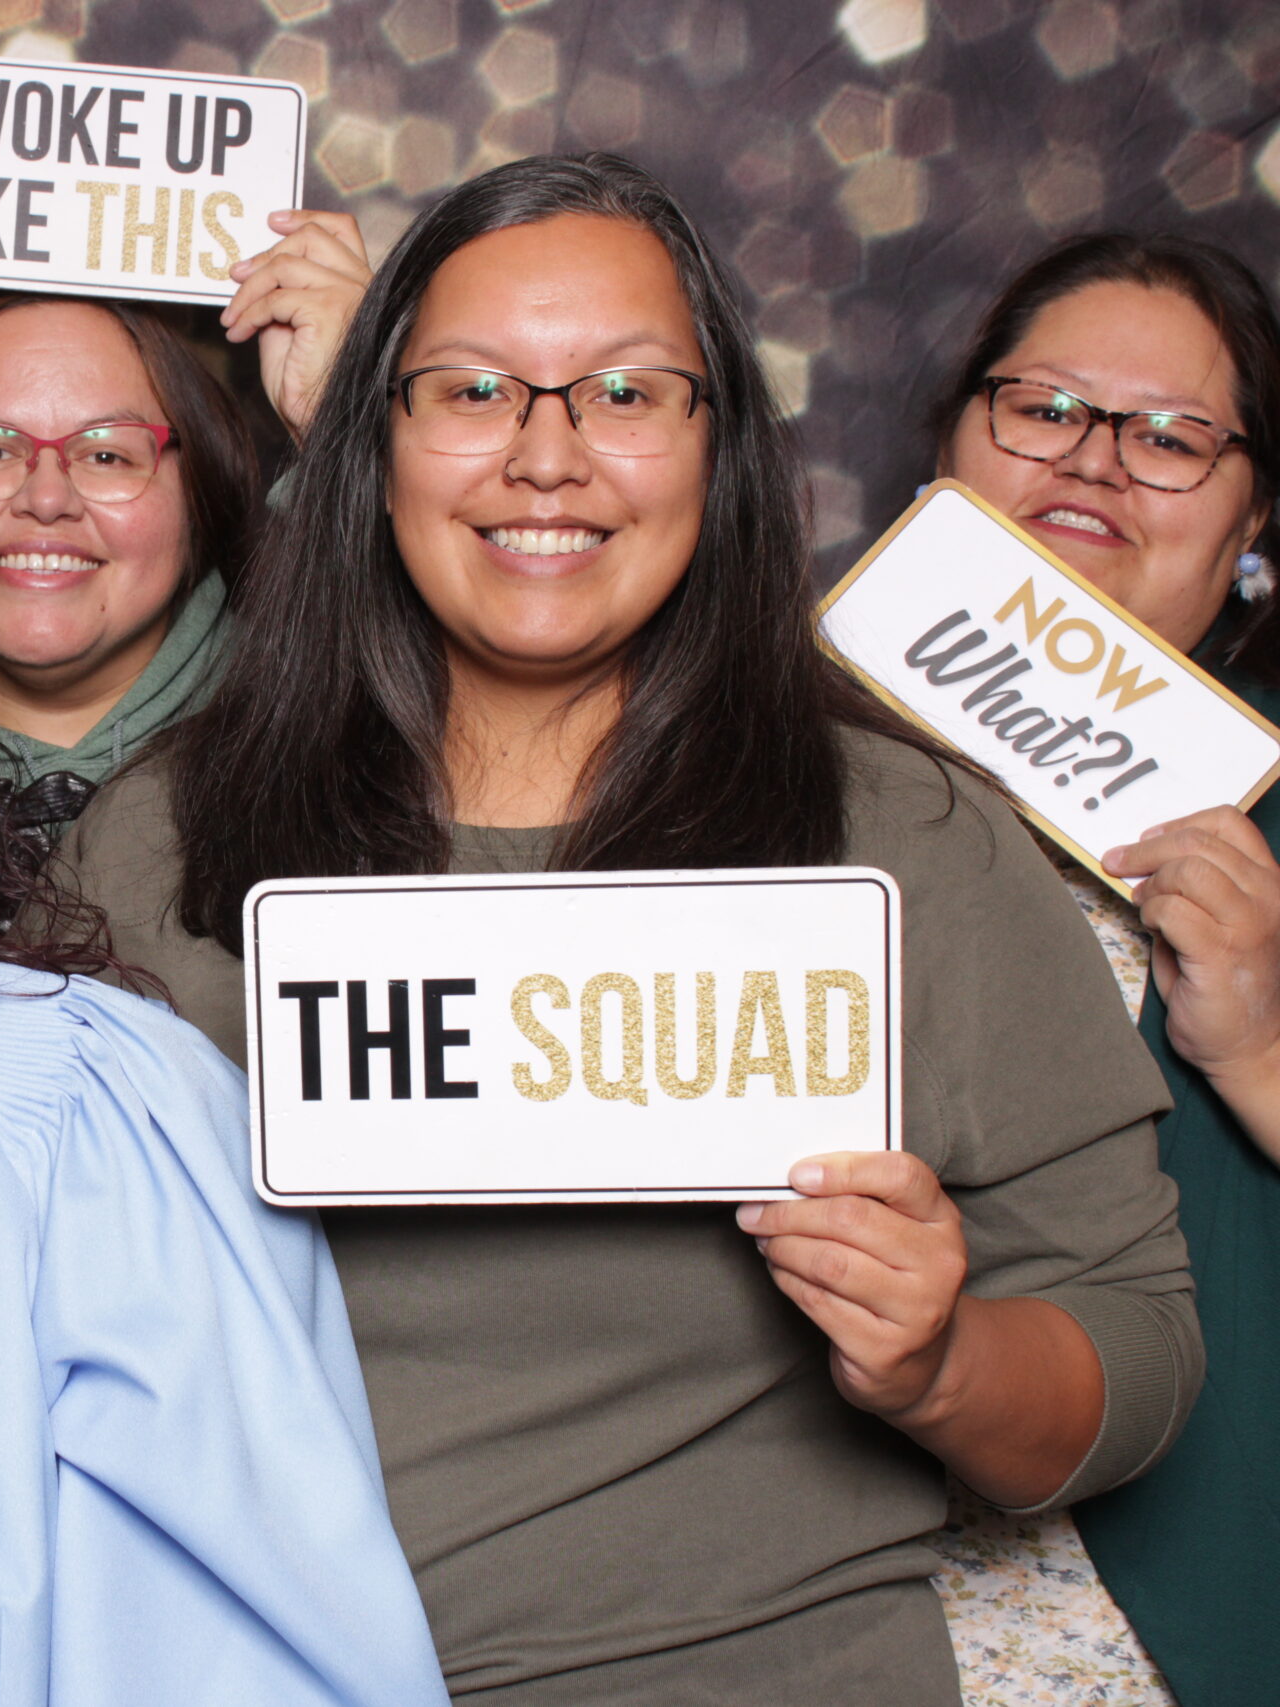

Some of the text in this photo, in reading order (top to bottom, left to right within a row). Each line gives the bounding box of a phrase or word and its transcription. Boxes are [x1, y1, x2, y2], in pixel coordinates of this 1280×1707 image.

[166, 93, 253, 175] UP
[76, 180, 245, 281] THIS
[904, 609, 1160, 811] What?!
[993, 576, 1170, 713] NOW
[278, 969, 871, 1107] THE SQUAD
